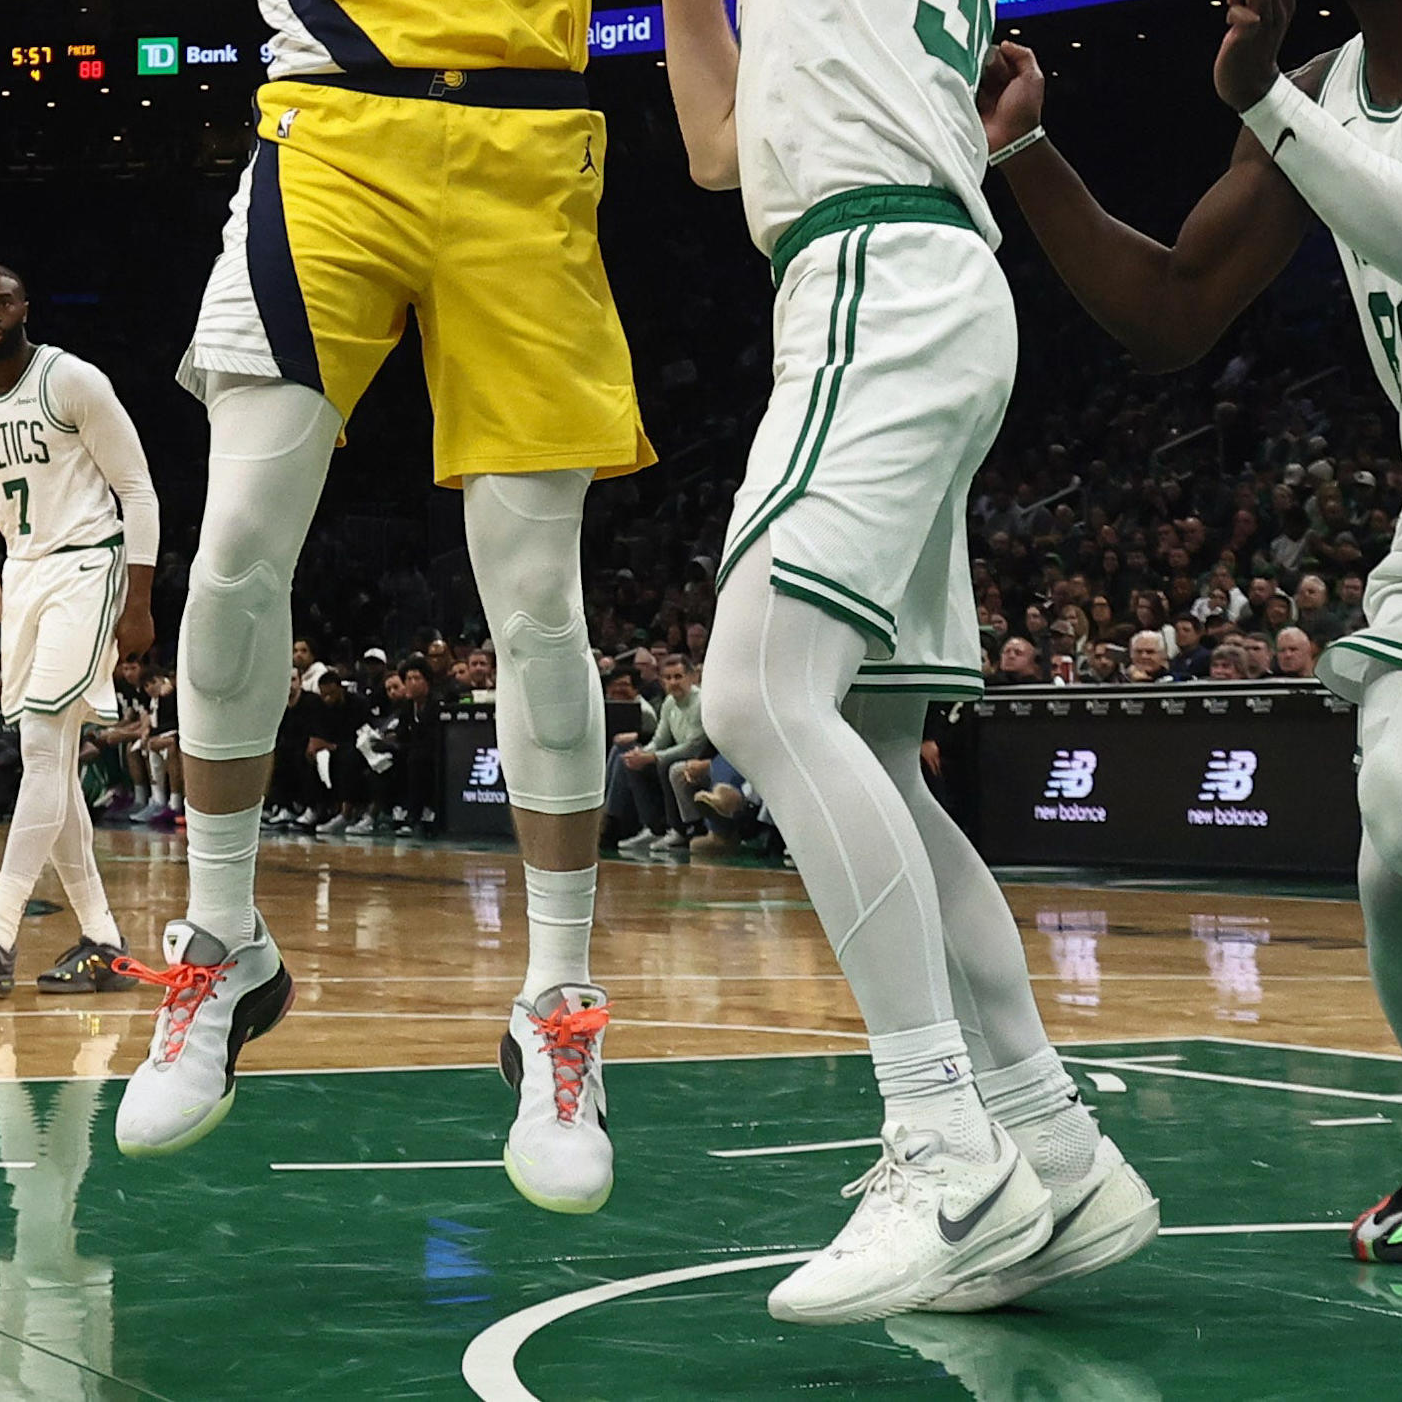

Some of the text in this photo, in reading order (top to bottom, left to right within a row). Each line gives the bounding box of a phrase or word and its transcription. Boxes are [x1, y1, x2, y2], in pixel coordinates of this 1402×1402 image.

[12, 46, 52, 66] 5:57
[141, 43, 238, 69] TD Bank
[79, 60, 103, 79] 88
[2, 477, 32, 536] 7
[1034, 802, 1107, 822] new balance
[1187, 805, 1269, 827] new balance
